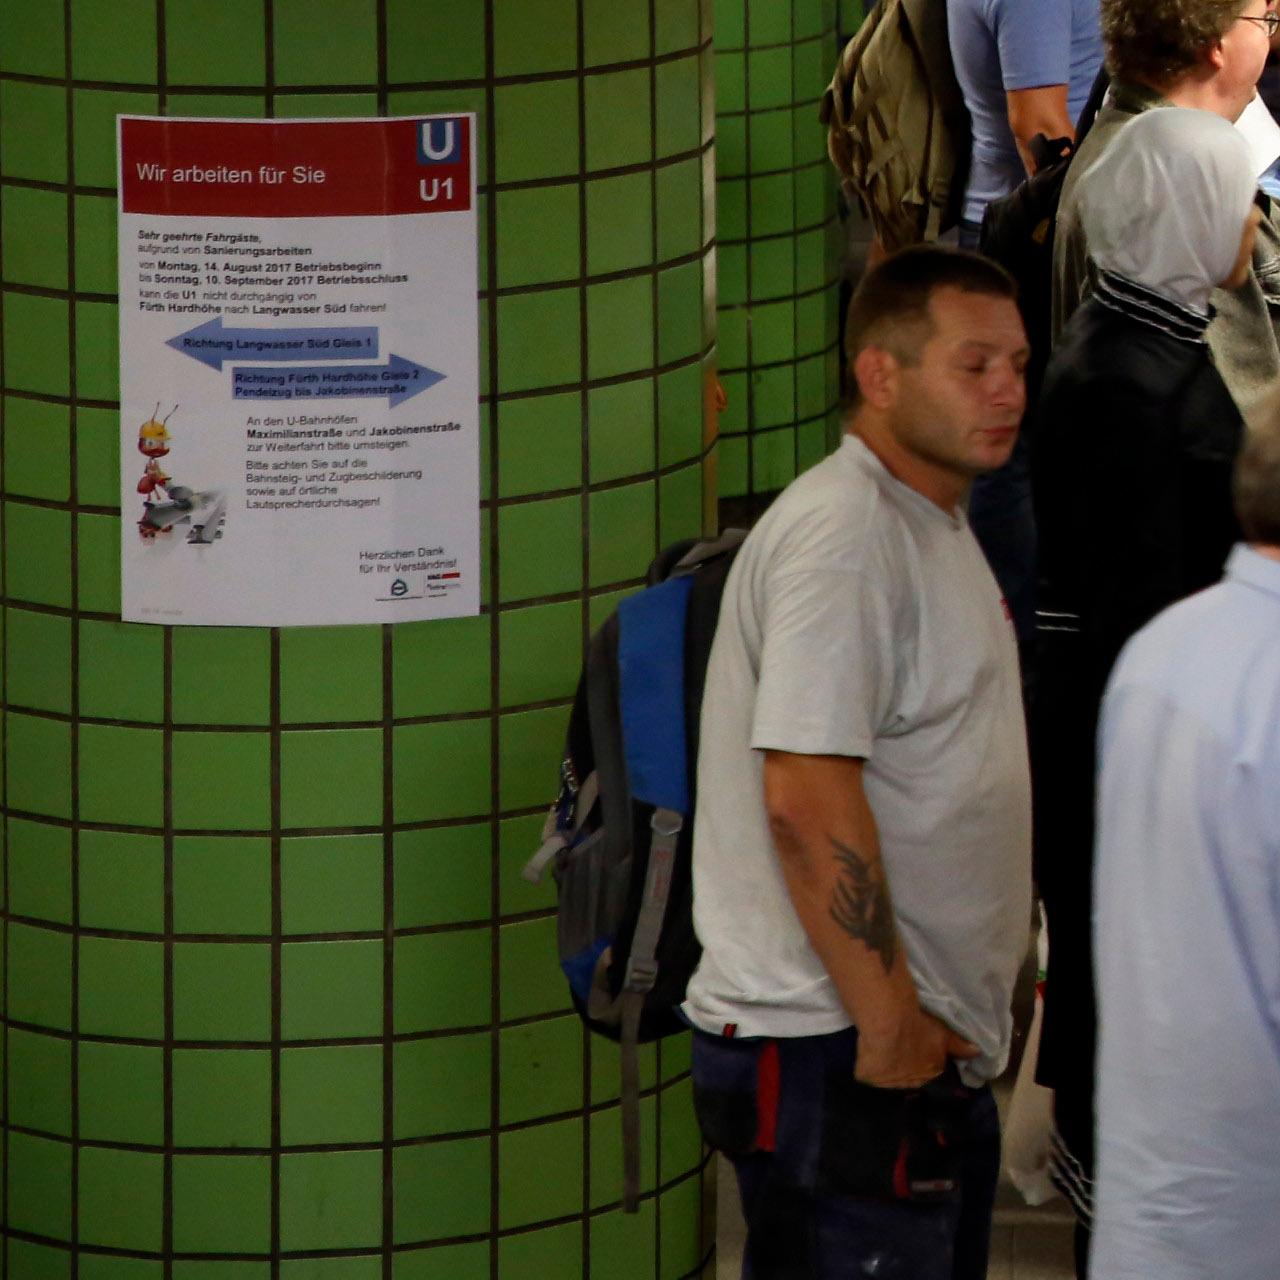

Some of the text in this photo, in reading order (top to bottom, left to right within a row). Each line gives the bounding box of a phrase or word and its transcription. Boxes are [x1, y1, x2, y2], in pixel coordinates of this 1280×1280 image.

[422, 121, 455, 160] U
[136, 163, 326, 185] Wir arbeiten für Sie
[420, 177, 453, 202] U1
[138, 230, 261, 244] Sehr geehrte Fahrgäste,
[138, 244, 313, 257] aufgrund von Sanierungsarbeiten
[139, 261, 155, 270] von
[204, 263, 219, 271] 14.
[223, 263, 262, 274] August
[265, 263, 291, 272] 2017
[295, 262, 382, 273] Betriebsbeginn
[139, 273, 152, 282] bis
[224, 276, 284, 287] September
[287, 276, 313, 285] 2017
[139, 289, 160, 298] kann
[163, 290, 179, 299] die
[182, 291, 196, 299] U1
[203, 291, 228, 300] nicht
[298, 293, 317, 301] von
[139, 302, 165, 312] Fürth
[168, 303, 221, 314] Hardhöhe
[224, 305, 249, 313] nach
[252, 305, 321, 317] Langwasser
[324, 304, 346, 314] Süd
[183, 338, 233, 351] Richtung
[236, 339, 304, 351] Langwasser
[235, 373, 285, 385] Richtung
[235, 387, 292, 399] Pendelzug
[295, 386, 312, 396] bis
[247, 416, 260, 426] An
[263, 416, 284, 426] den
[247, 422, 461, 439] Maximilianstraße und Jakobinenstraße
[247, 443, 263, 452] zur
[265, 441, 325, 452] Weiterfahrt
[246, 458, 368, 470] Bitte achten Sie auf die
[305, 473, 325, 482] und
[246, 486, 275, 496] sowie
[279, 486, 296, 496] auf
[360, 546, 444, 560] Herzlichen Dank
